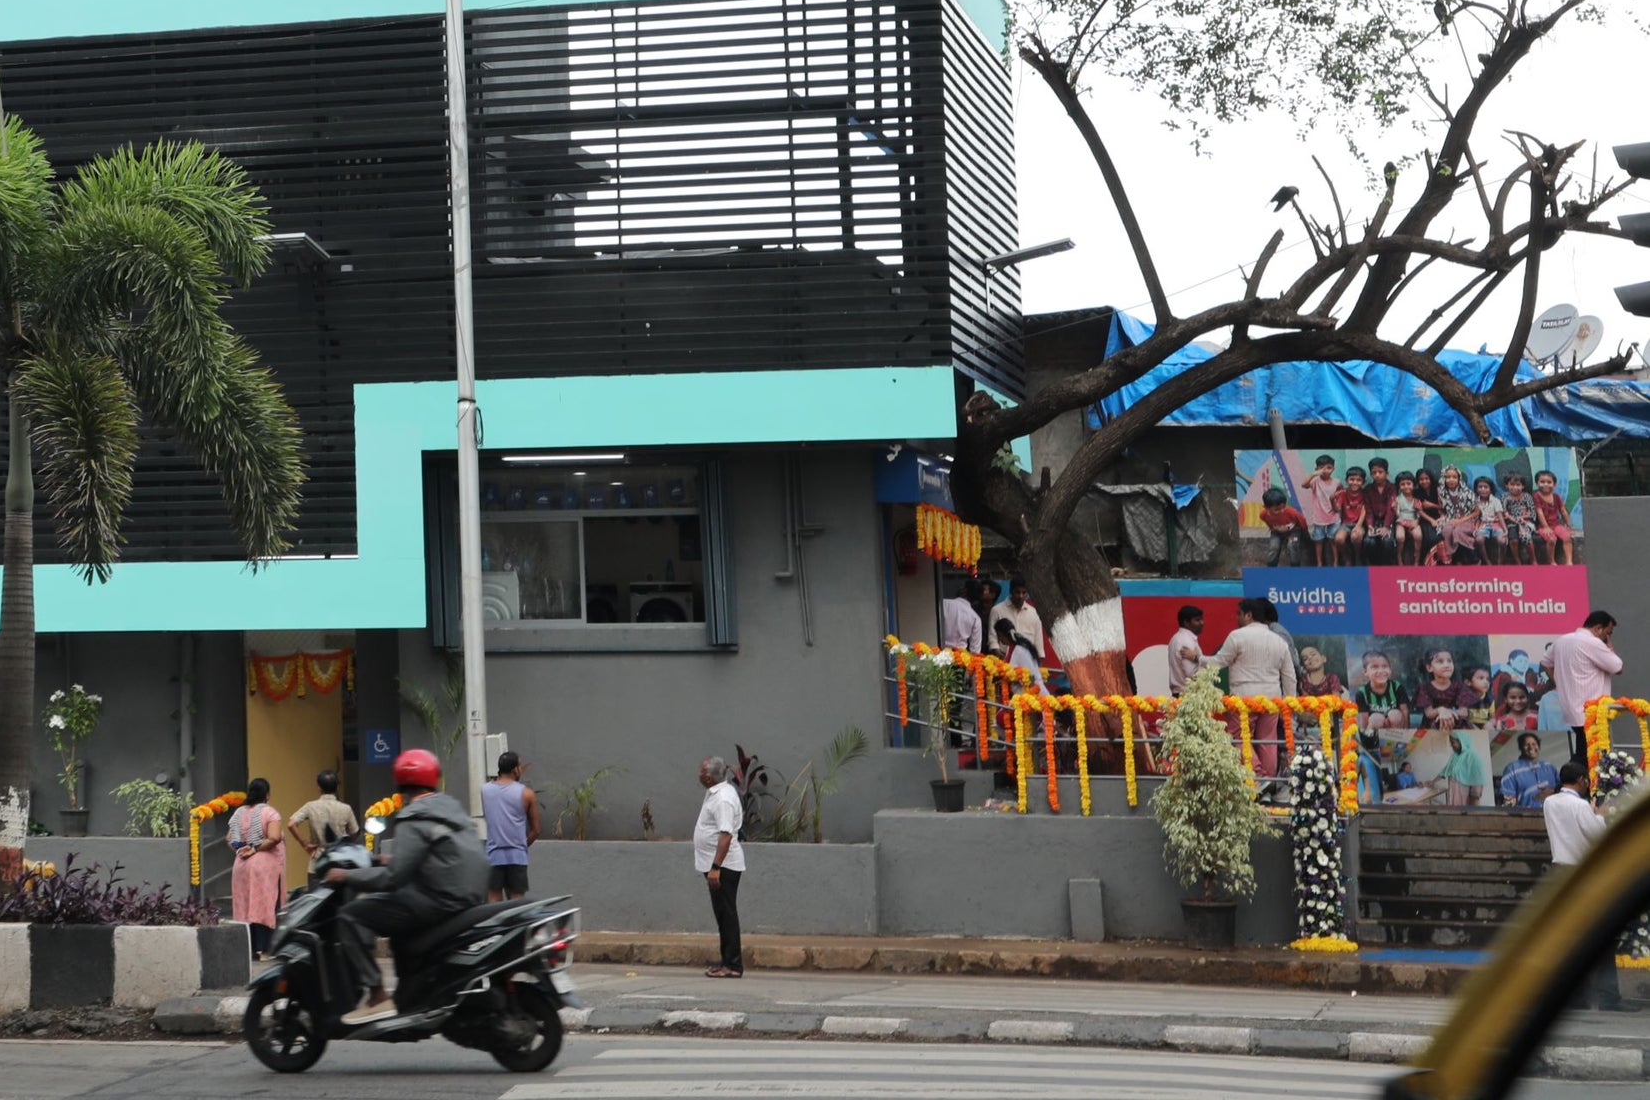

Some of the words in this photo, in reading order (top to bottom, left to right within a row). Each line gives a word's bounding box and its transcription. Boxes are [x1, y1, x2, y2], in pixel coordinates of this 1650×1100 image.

[1397, 578, 1523, 597] Transforming
[1399, 599, 1493, 614] sanitation
[1497, 599, 1514, 613] in
[1518, 599, 1566, 613] India
